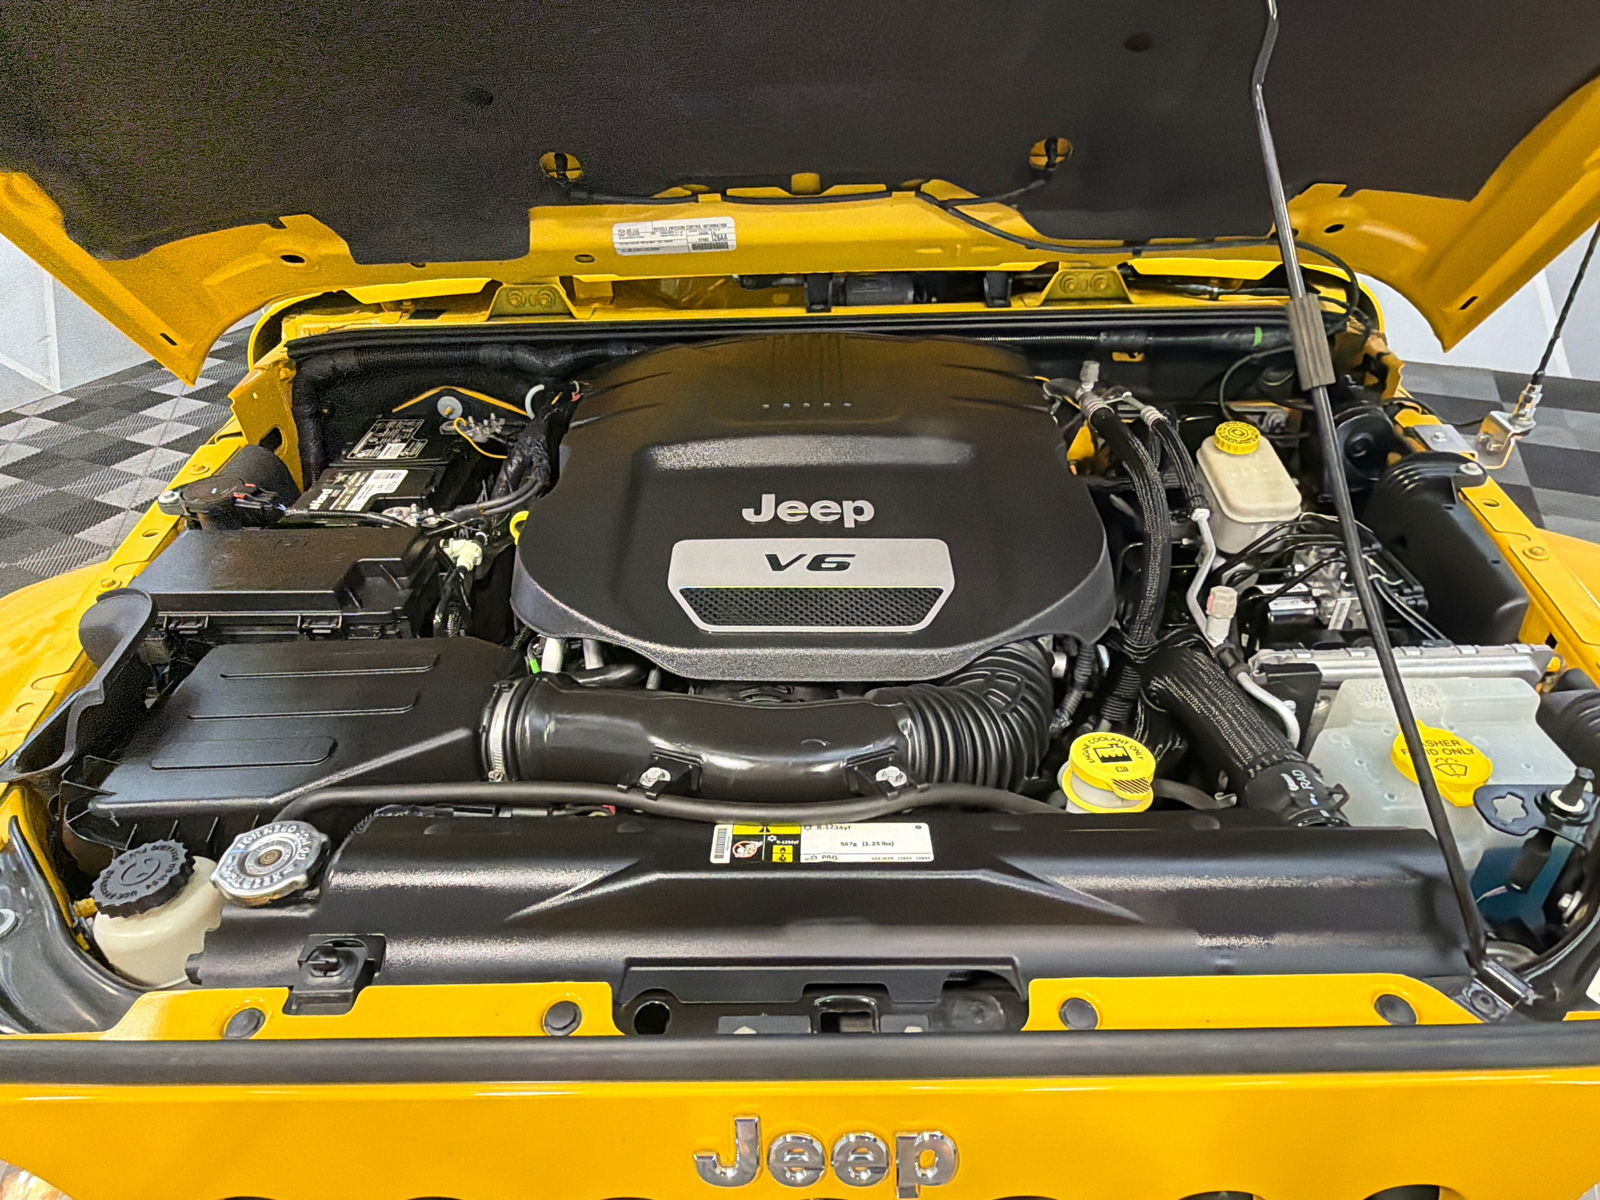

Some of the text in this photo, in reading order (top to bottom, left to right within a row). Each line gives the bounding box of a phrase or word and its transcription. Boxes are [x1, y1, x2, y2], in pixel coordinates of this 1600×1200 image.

[741, 493, 875, 528] Jeep
[765, 553, 856, 572] V6
[1088, 736, 1129, 745] COOLANT
[1129, 745, 1145, 761] ONLY
[1400, 747, 1475, 756] FID ONLY
[693, 1115, 960, 1199] Jeep
